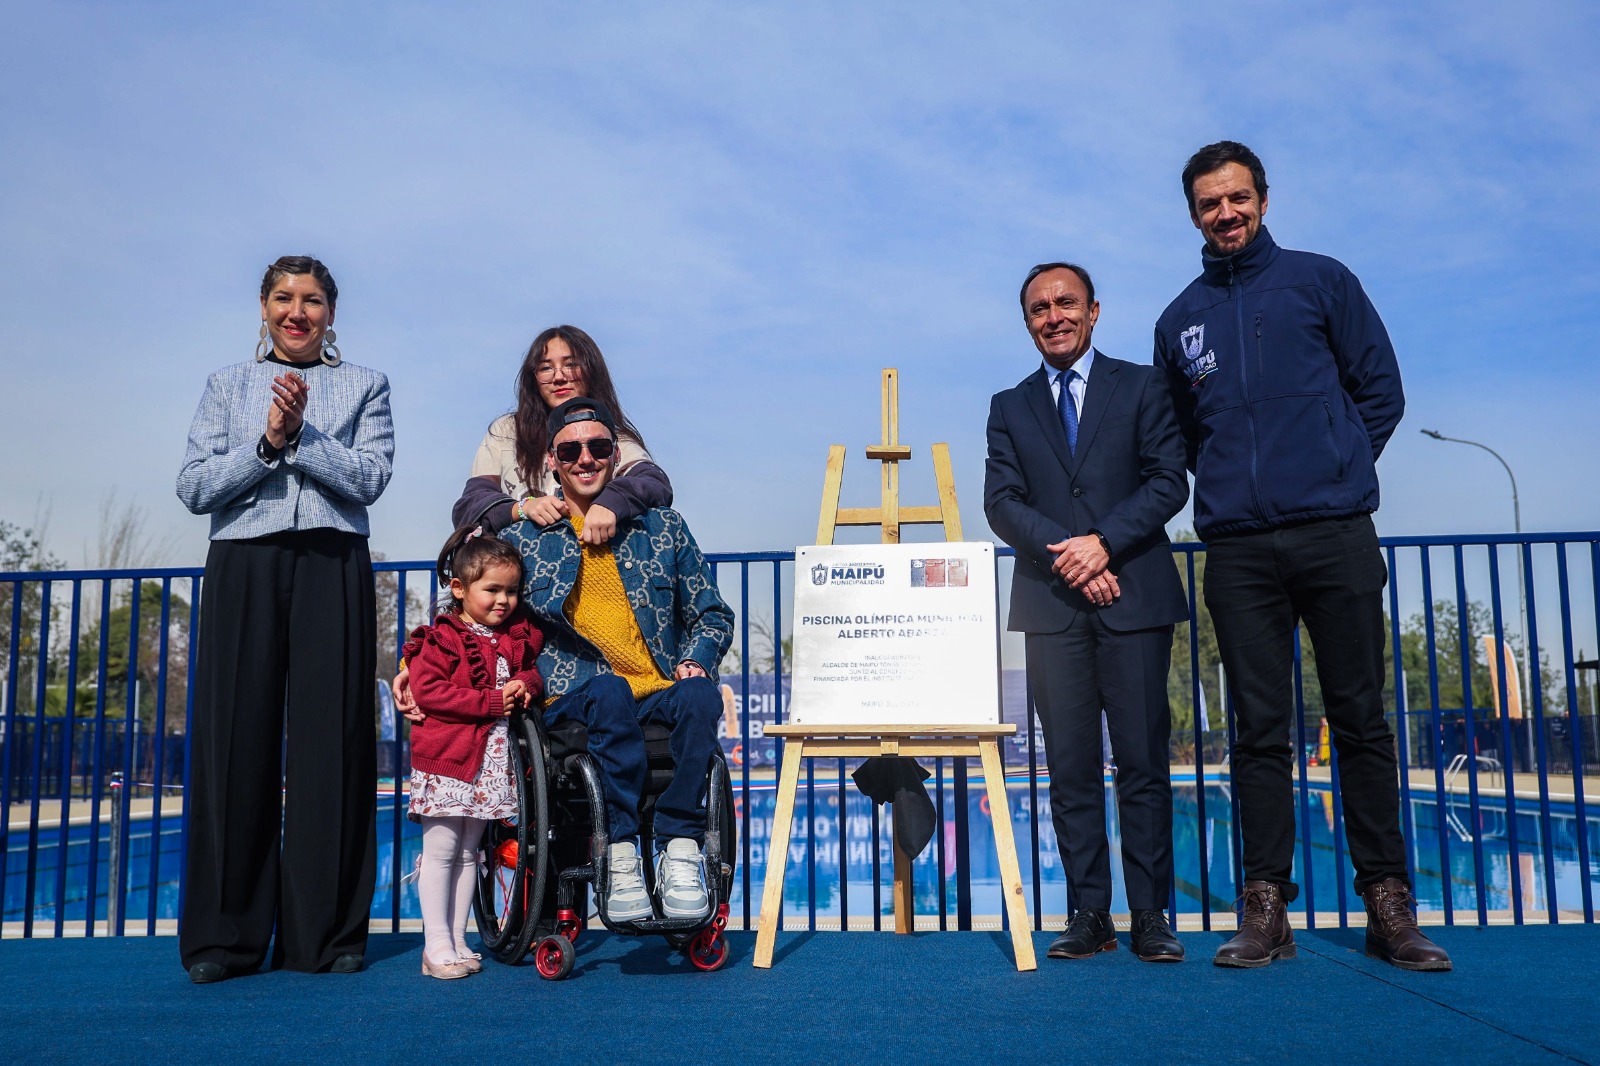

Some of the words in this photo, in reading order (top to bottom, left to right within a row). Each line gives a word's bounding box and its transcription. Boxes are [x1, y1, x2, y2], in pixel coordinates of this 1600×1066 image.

[831, 564, 884, 579] MAIPÚ
[802, 616, 852, 626] PISCINA
[854, 612, 914, 625] OLÍMPICA
[837, 629, 895, 639] ALBERTO
